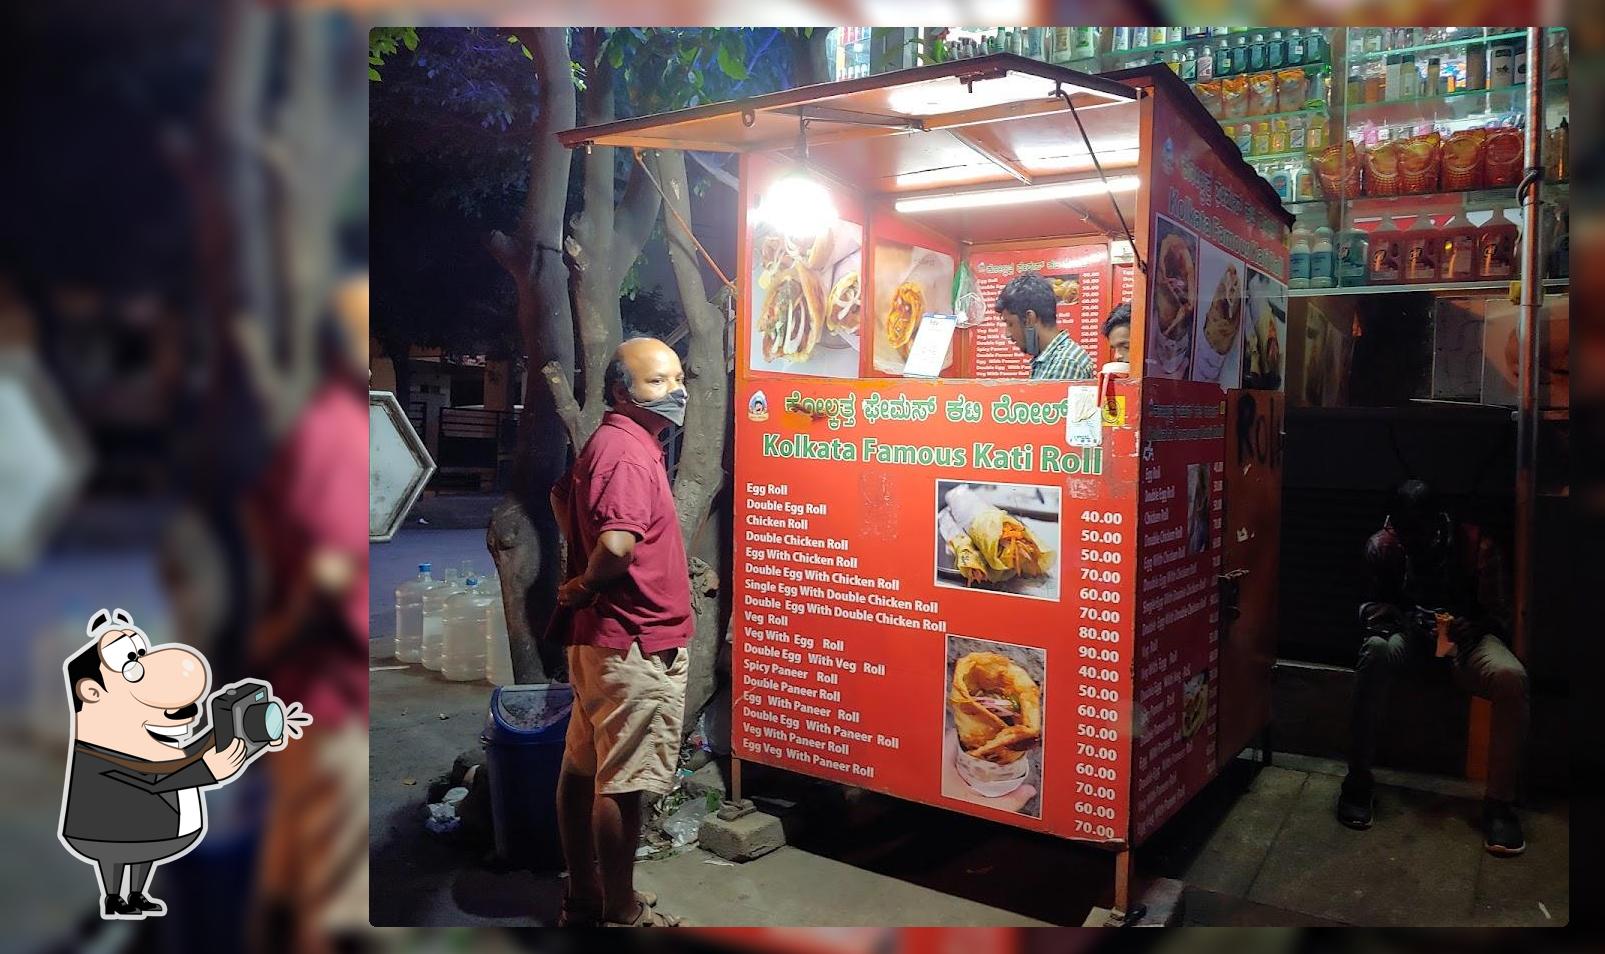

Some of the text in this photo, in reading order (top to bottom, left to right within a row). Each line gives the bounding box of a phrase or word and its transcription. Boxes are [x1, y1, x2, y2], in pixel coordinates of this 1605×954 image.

[763, 433, 1103, 475] Kolkata Famous Kati Roll
[747, 483, 788, 496] Egg Roll
[747, 499, 826, 515] Double Egg Roll
[746, 515, 808, 530] Chicken Roll
[1081, 511, 1122, 525] 40.00
[746, 531, 848, 550] Double Chicken Roll
[1081, 530, 1122, 544] 50.00
[746, 547, 857, 568] Egg With Chicken Roll
[1081, 549, 1122, 564] 50.00
[746, 563, 899, 590] Double Egg With Chicken Roll
[1081, 568, 1121, 584] 70.00
[745, 579, 938, 613] Single Egg With Double Chicken Roll
[1080, 588, 1120, 603] 60.00
[745, 595, 946, 632] Double Egg With Double Chicken Roll
[745, 611, 788, 626] Veg Roll
[1080, 607, 1120, 623] 70.00
[744, 627, 844, 651] Veg With Egg Roll
[1079, 627, 1120, 643] 80.00
[744, 643, 885, 675] Double Egg With Veg Roll
[1079, 646, 1119, 663] 90.00
[744, 659, 838, 684] Spicy Paneer Roll
[1078, 666, 1119, 682] 40.00
[744, 675, 840, 702] Double Paneer Roll
[1079, 685, 1118, 702] 50.00
[744, 691, 859, 722] Egg With Paneer Roll
[1078, 705, 1118, 722] 60.00
[744, 707, 898, 748] Double Egg With Paneer Roll
[1078, 724, 1117, 741] 50.00
[743, 722, 848, 755] Veg With Paneer Roll
[744, 738, 874, 778] Egg Veg With Paneer Roll
[1077, 743, 1117, 761] 70.00
[1076, 763, 1116, 780] 60.00
[1076, 782, 1115, 800] 70.00
[1075, 802, 1115, 819] 60.00
[1075, 820, 1114, 838] 70.00
